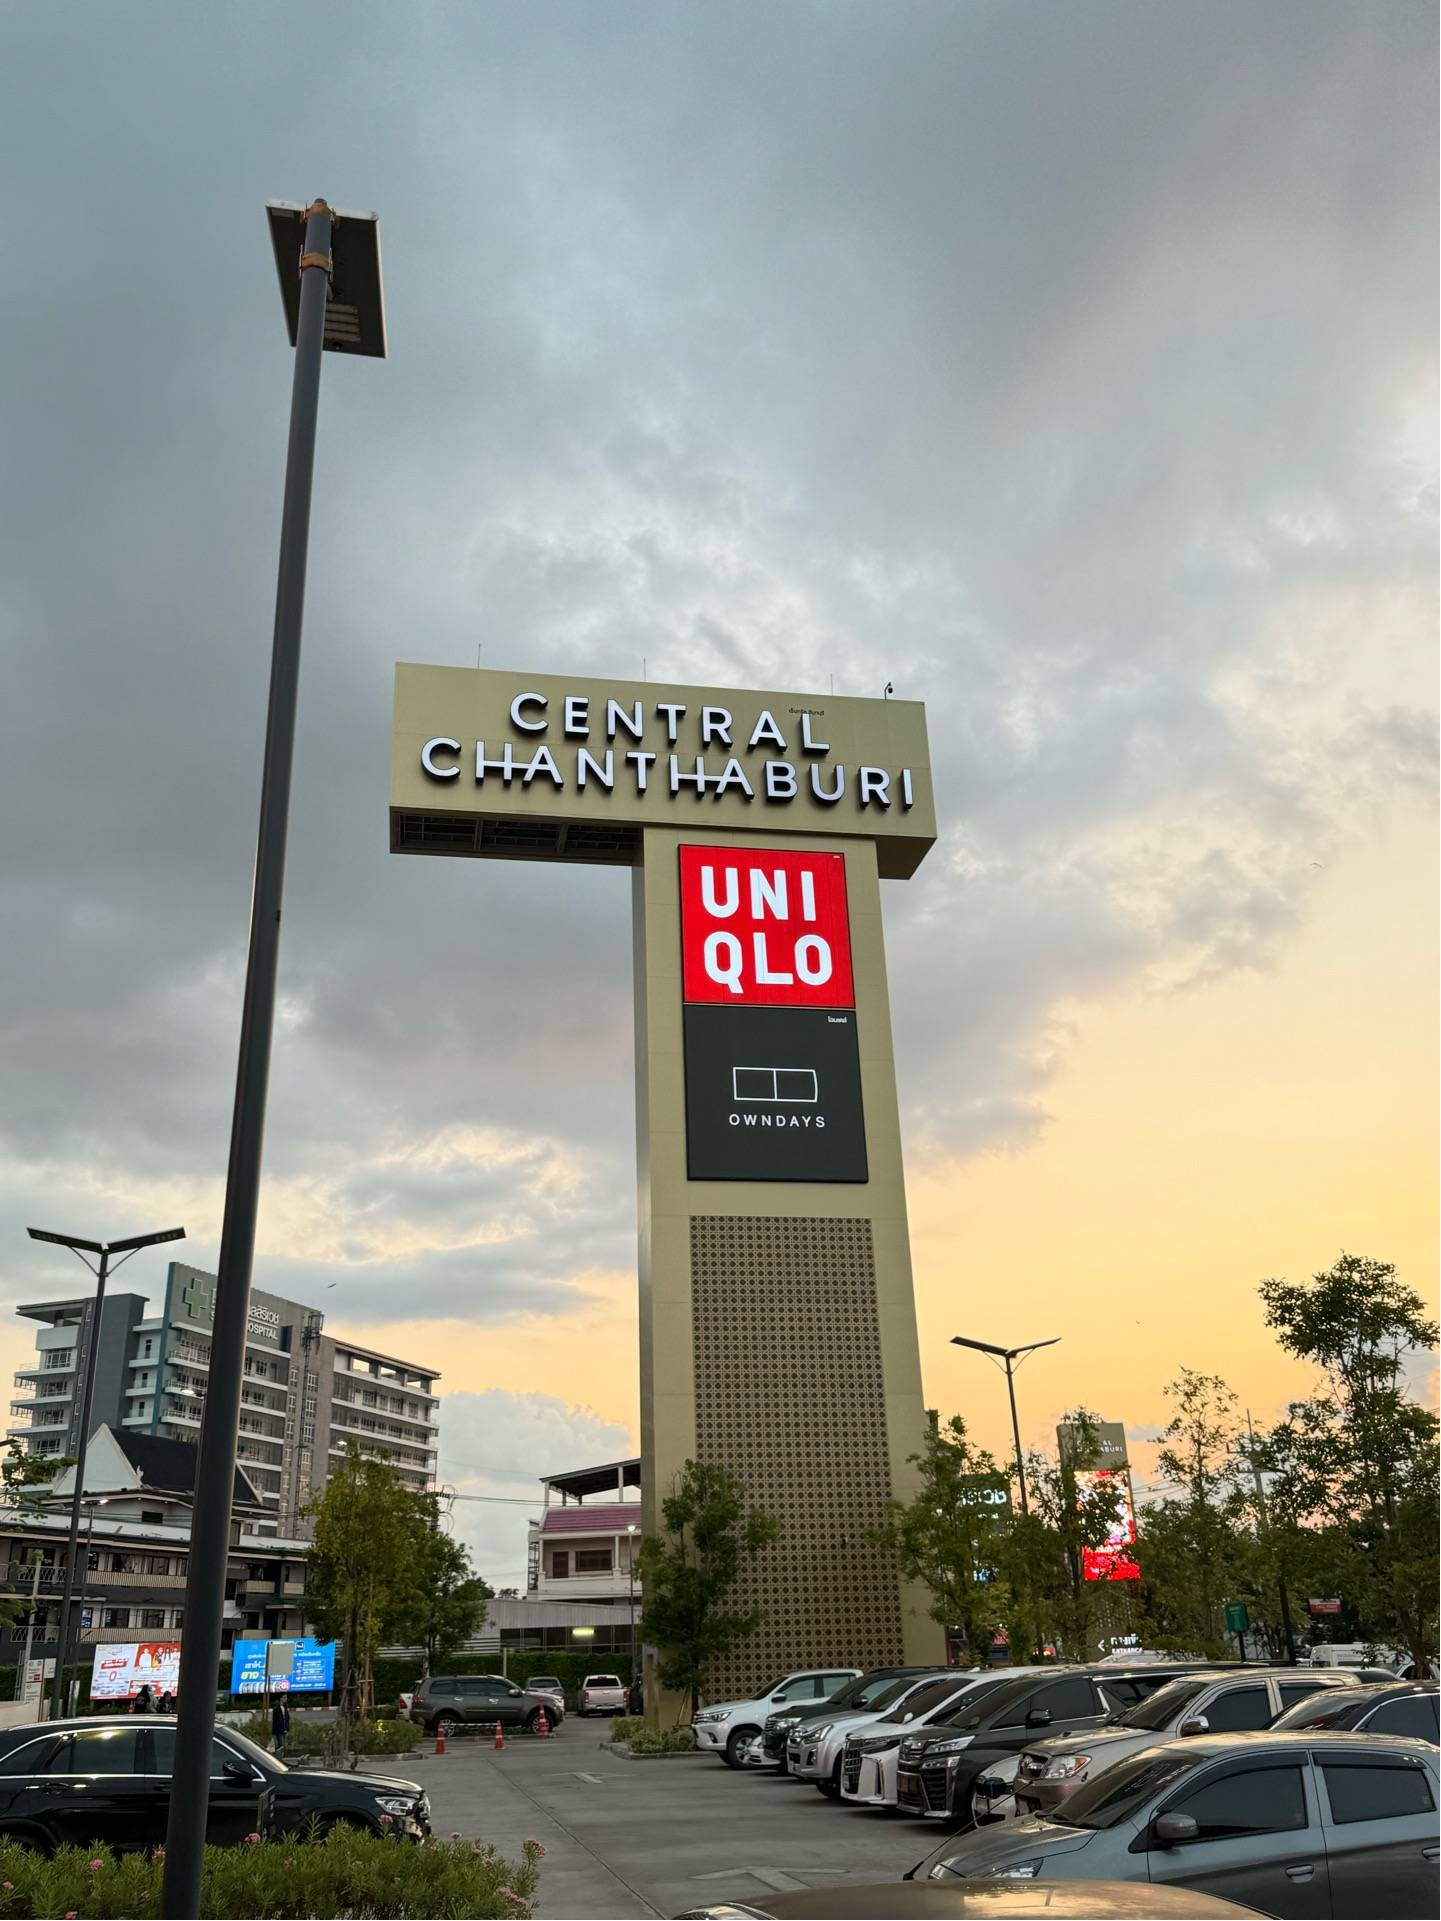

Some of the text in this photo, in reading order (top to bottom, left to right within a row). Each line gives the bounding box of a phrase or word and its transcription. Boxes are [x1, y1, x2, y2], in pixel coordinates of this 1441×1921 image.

[510, 692, 831, 752] CENTRAL
[420, 737, 914, 806] CHANTHABURI
[701, 865, 817, 921] UNI
[703, 931, 833, 994] QLO
[728, 1113, 826, 1128] OWNDAYS
[248, 1322, 278, 1340] OSPITAL
